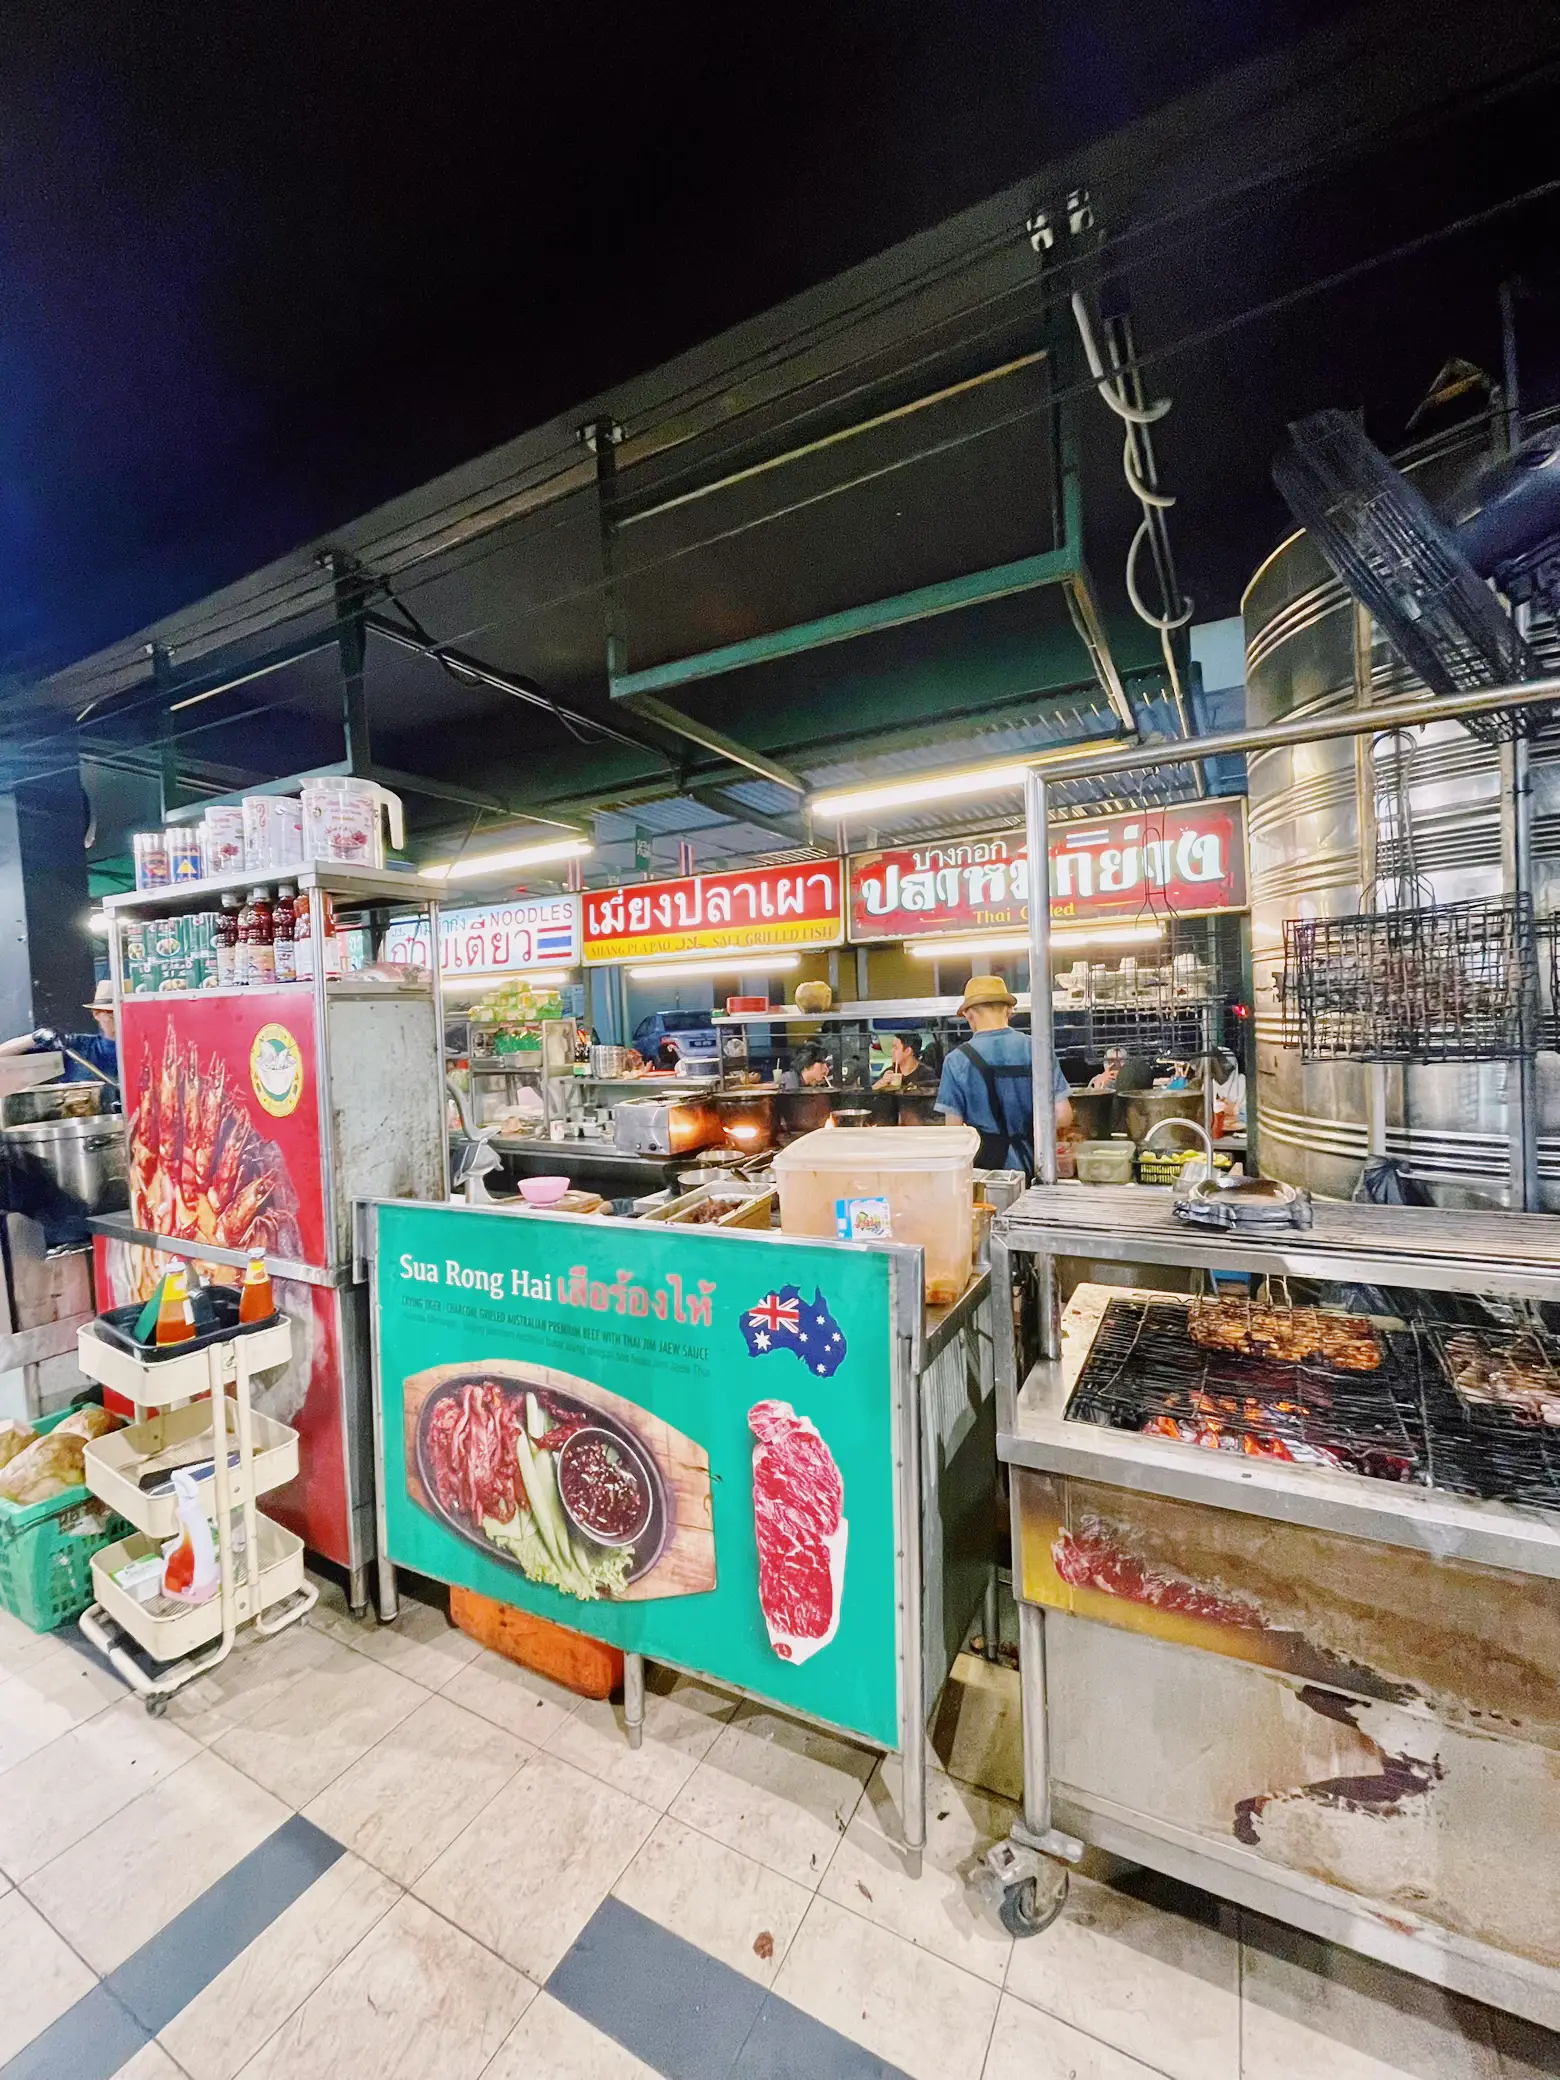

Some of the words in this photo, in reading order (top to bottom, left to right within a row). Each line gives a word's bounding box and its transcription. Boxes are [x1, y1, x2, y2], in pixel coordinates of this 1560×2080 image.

[912, 840, 1007, 871] บางกอก
[489, 903, 573, 927] NOODLES
[588, 873, 833, 935] เมี่ยงปลาเผา
[974, 908, 1011, 925] Thai
[399, 1254, 438, 1284] Sua
[445, 1259, 504, 1300] Rong
[511, 1269, 552, 1301] Hai
[557, 1265, 717, 1327] เสือร้องไห้
[506, 1312, 547, 1332] AUSTRALIAN
[549, 1320, 581, 1338] PREMIUM
[582, 1326, 600, 1341] BEEF
[601, 1331, 622, 1345] WITH
[623, 1334, 641, 1349] THAI
[658, 1340, 681, 1356] JAEW
[682, 1343, 709, 1361] SAUCE
